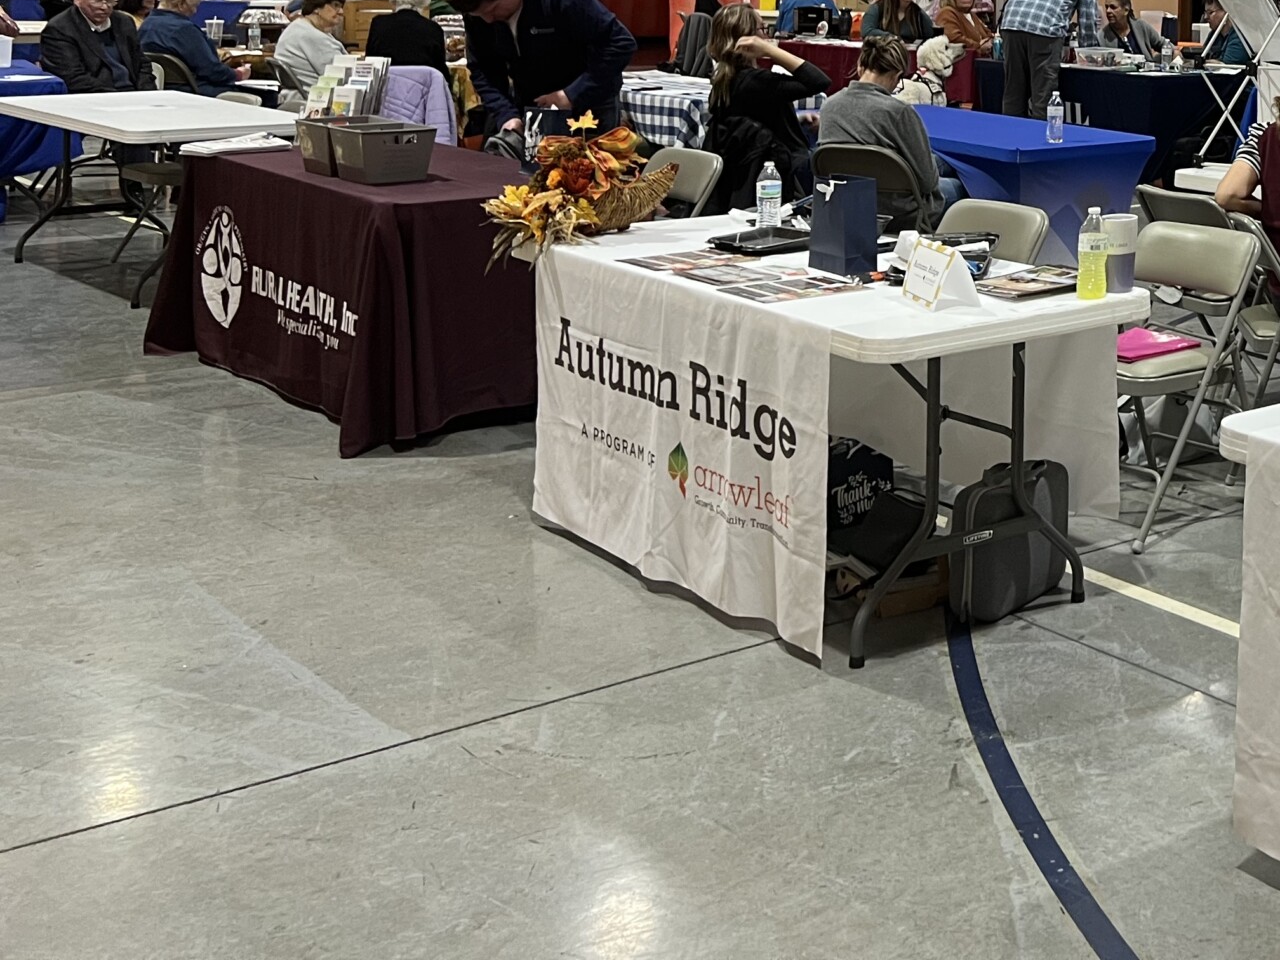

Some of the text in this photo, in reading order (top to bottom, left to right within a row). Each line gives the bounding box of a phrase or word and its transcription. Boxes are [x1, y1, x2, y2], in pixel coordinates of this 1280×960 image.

[251, 265, 285, 307] RURL
[555, 316, 798, 462] Autumn Ridge
[580, 423, 589, 439] A
[693, 465, 791, 530] arrowleaf
